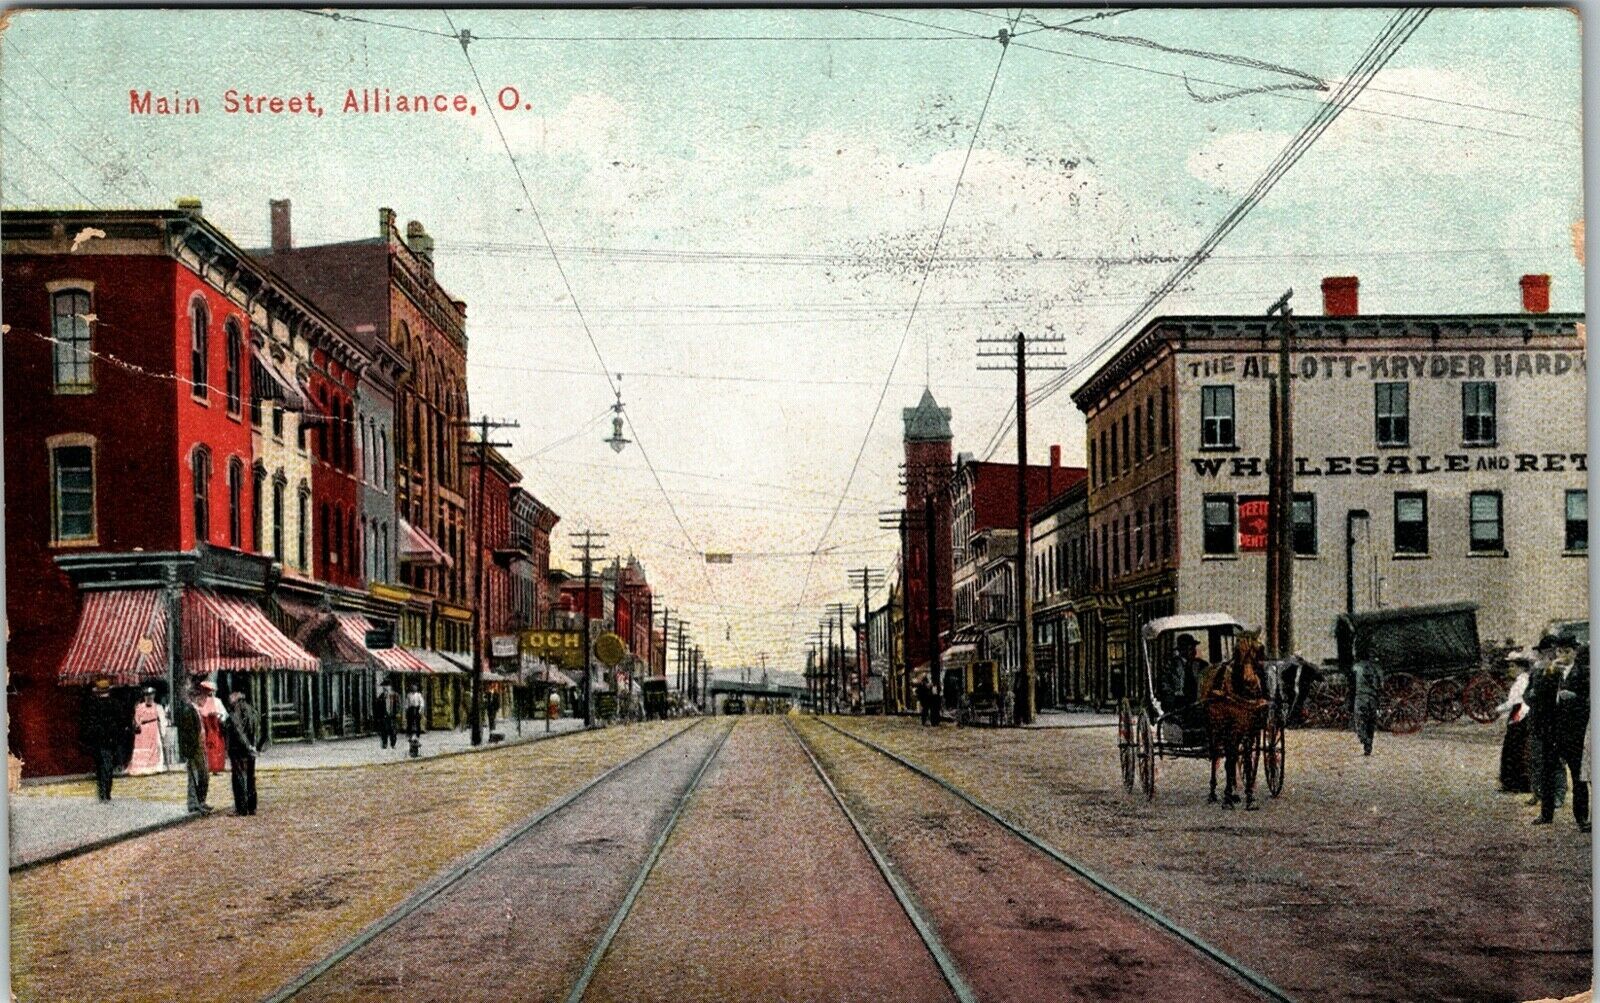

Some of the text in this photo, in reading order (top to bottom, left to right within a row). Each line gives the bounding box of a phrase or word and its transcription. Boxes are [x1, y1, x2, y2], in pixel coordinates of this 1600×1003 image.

[1188, 355, 1236, 378] THE
[1242, 354, 1485, 379] ALOTT-KRYDER
[1190, 455, 1470, 478] WHLESALE
[1476, 456, 1509, 472] AND
